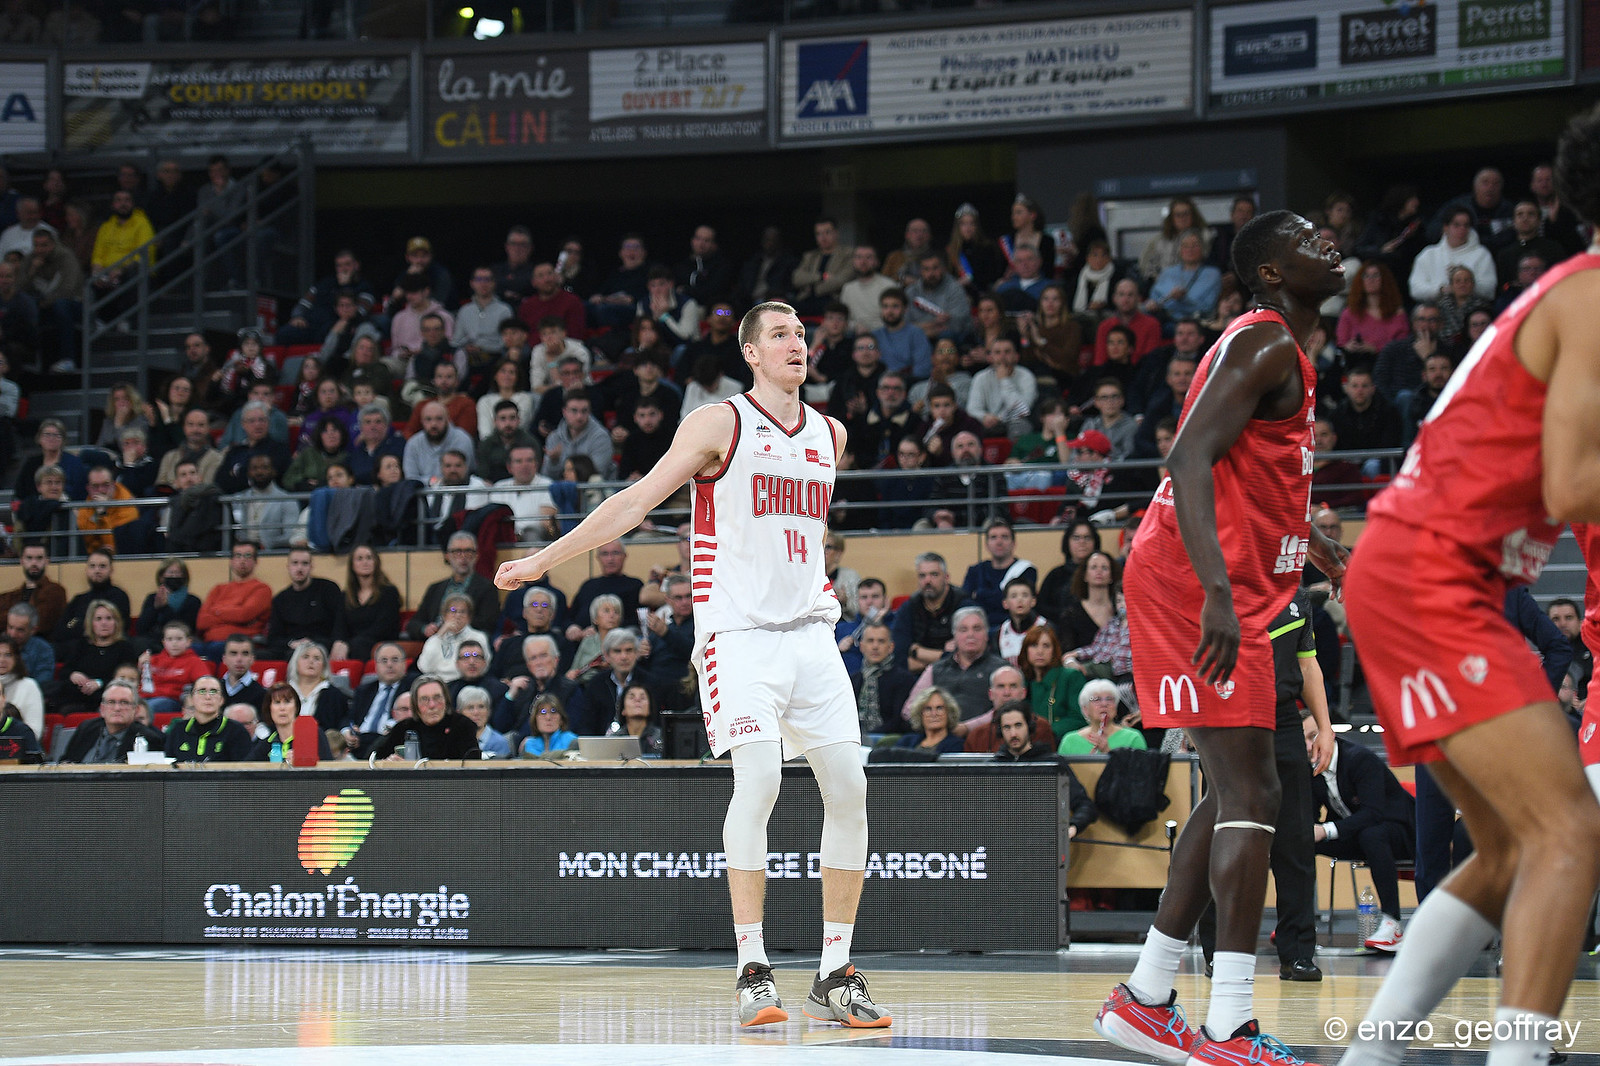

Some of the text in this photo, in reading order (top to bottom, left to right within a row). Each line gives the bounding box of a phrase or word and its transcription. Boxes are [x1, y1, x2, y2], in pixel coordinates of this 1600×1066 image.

[1348, 12, 1431, 42] Perret
[1465, 0, 1544, 28] Perret
[634, 47, 727, 71] 2 Place
[940, 43, 1120, 73] Philippe MATHIEU
[1347, 37, 1429, 58] PAYSAGE
[169, 80, 367, 103] COLINT SCHOOL!
[438, 56, 574, 101] la mie
[929, 73, 1017, 92] L'Esprit
[622, 89, 693, 110] OUVERT
[797, 79, 858, 114] AXA
[434, 105, 571, 147] CÂLINE
[751, 472, 833, 525] CHALON
[784, 528, 808, 565] 14
[739, 724, 761, 735] JOA
[559, 846, 988, 879] MON CHAUFGE DARBONÉ
[203, 876, 471, 927] Chalon'Énergie
